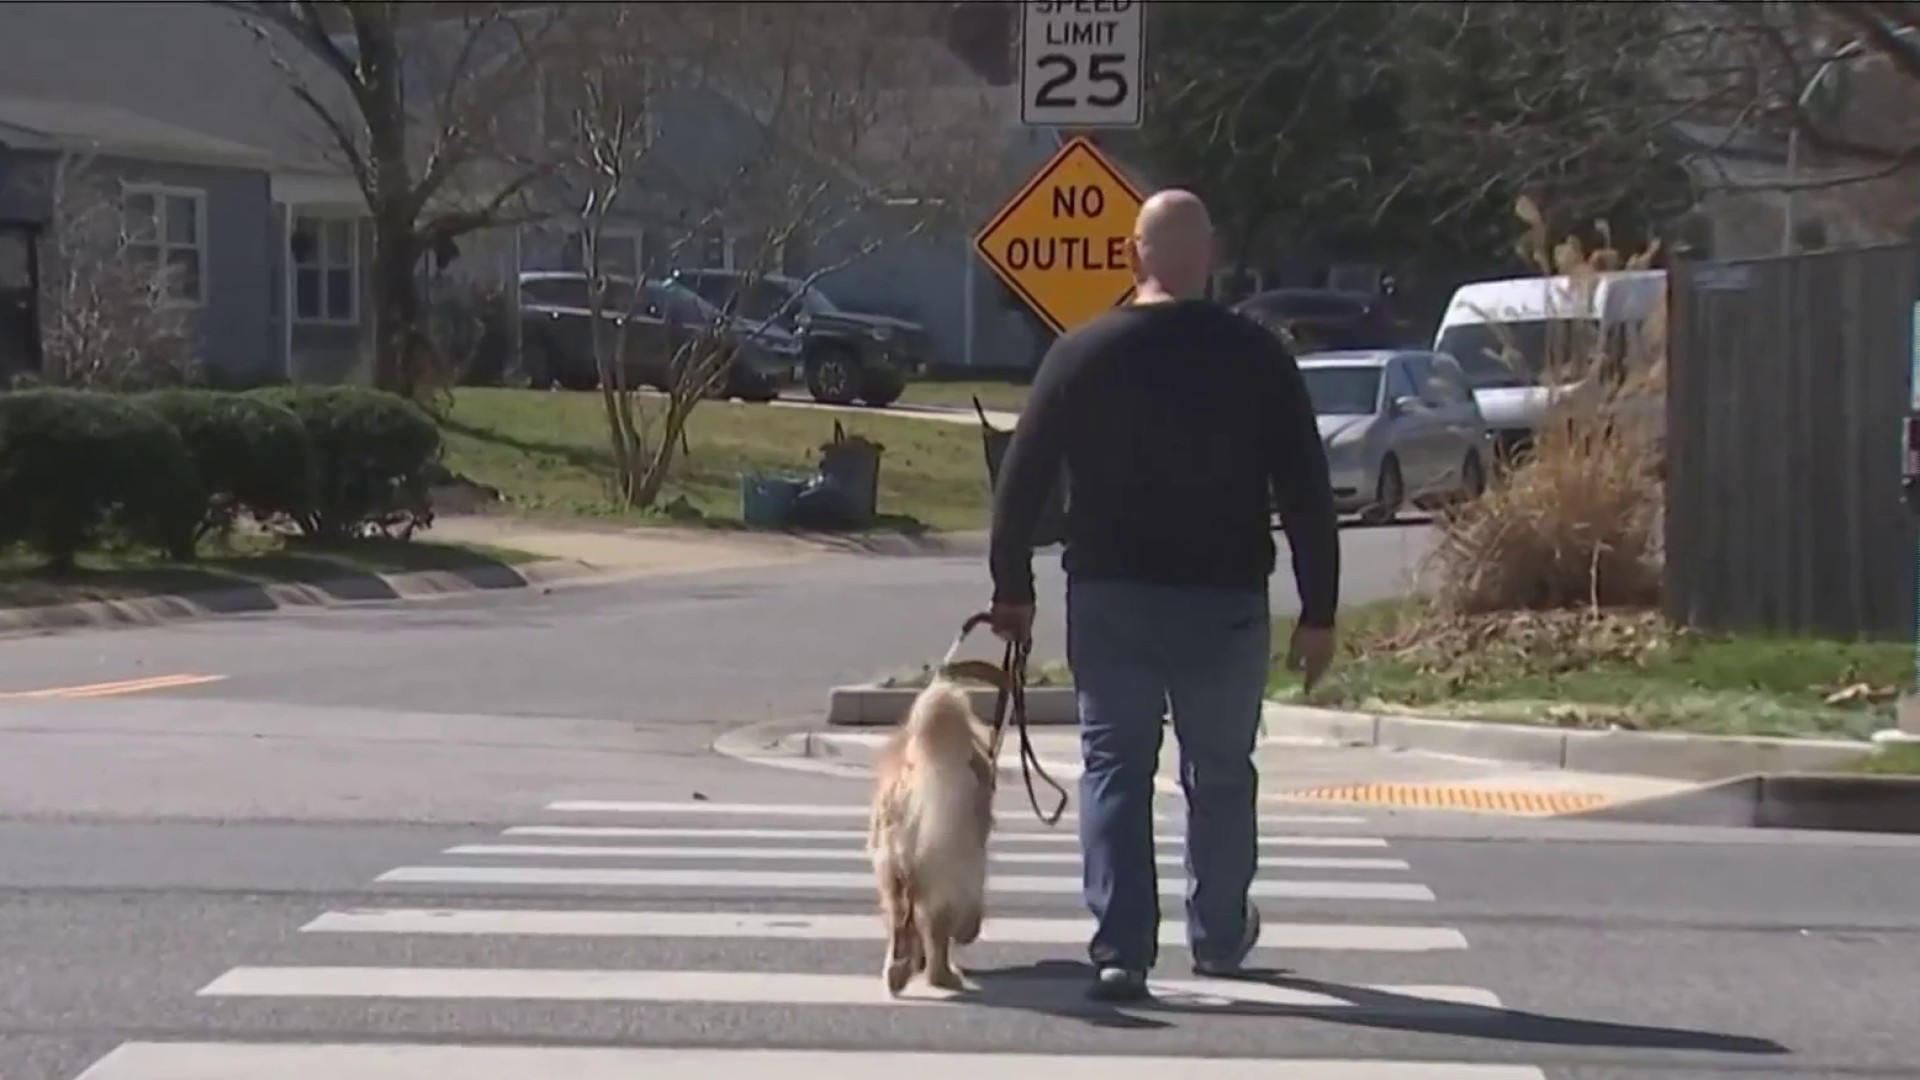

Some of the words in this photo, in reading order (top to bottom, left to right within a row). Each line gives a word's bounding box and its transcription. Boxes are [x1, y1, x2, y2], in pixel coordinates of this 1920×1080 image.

[1046, 21, 1119, 45] LIMIT
[1035, 53, 1128, 107] 25
[1053, 184, 1104, 218] NO
[1007, 236, 1128, 270] OUTLE
